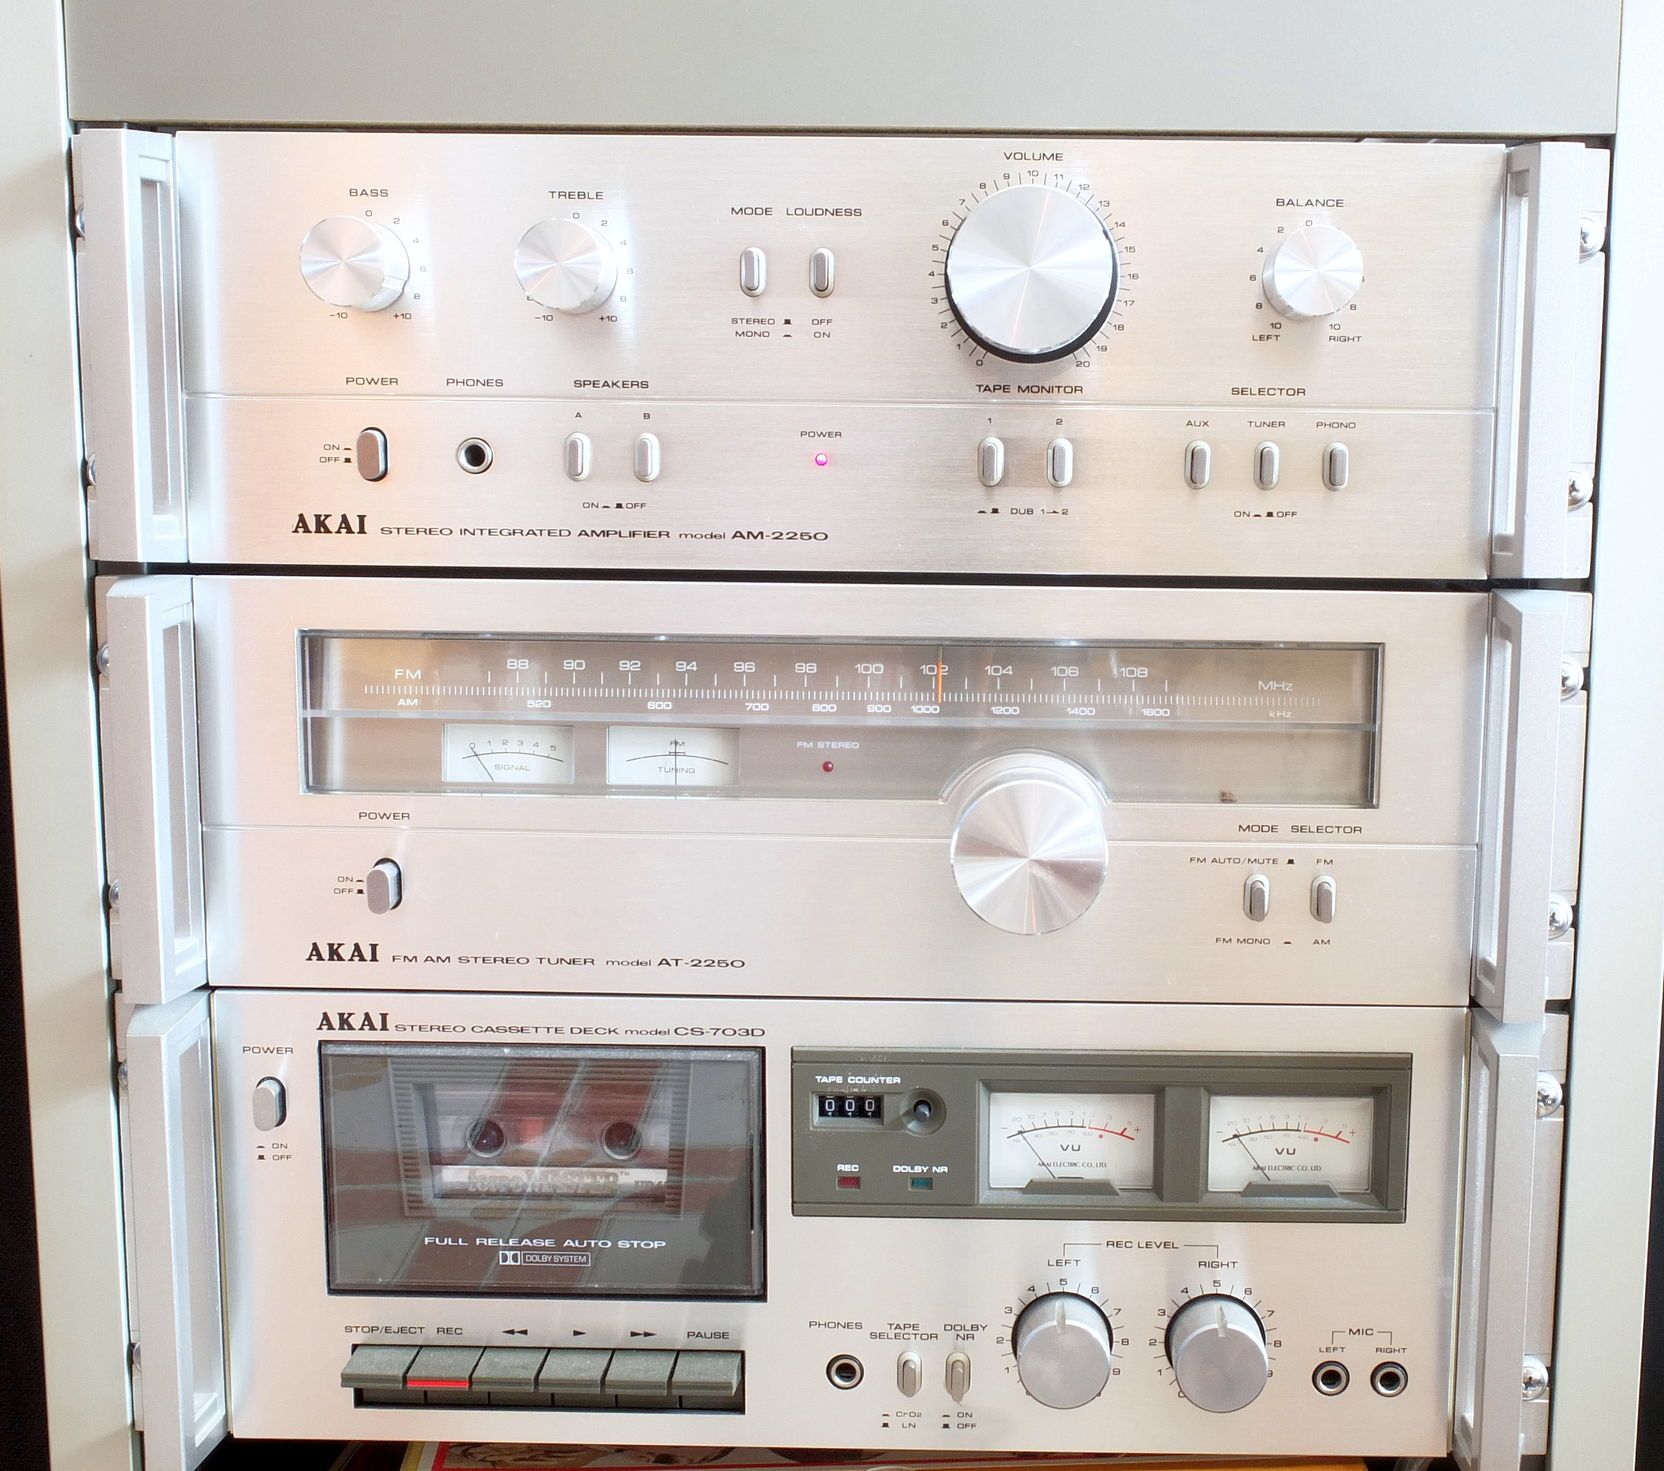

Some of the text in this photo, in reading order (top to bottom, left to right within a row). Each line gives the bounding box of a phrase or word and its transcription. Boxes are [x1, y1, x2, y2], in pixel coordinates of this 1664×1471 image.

[1004, 152, 1063, 161] VOLUME
[349, 189, 388, 197] BASS
[549, 191, 603, 200] TREBLE
[1276, 198, 1344, 207] BALANCE
[731, 207, 862, 216] MODE LOUDNESS
[812, 318, 832, 326] OFF
[346, 377, 398, 385] POWER
[446, 378, 503, 387] PHONES
[574, 380, 649, 389] SPEAKERS
[976, 385, 1083, 394] TAPE MONITOR
[1232, 387, 1305, 396] SELECTOR
[292, 513, 828, 541] AKAI STEREO INTEGRATED AMPLIFIER model AM-2250
[507, 659, 1148, 678] 88 90 92 94 96 98 100 102 104 106 108
[395, 669, 421, 679] FM
[1259, 681, 1293, 691] MHz
[527, 700, 551, 708] 520
[647, 701, 672, 710] 600
[745, 703, 769, 711] 700
[812, 704, 836, 712] 800
[911, 705, 939, 713] 1000
[991, 706, 1019, 714] 1200
[1142, 708, 1170, 716] 1600
[1270, 710, 1292, 718] kHz
[359, 812, 410, 820] POWER
[1291, 825, 1362, 834] SELECTOR
[306, 942, 379, 962] AKAI
[392, 955, 418, 963] FM
[424, 956, 450, 964] AM
[458, 956, 529, 965] STEREO
[536, 957, 594, 965] TUNER
[657, 958, 745, 968] AT-2250
[316, 1012, 389, 1031] AKAI
[395, 1024, 466, 1032] STEREO
[471, 1025, 564, 1034] CASSETTE
[570, 1026, 619, 1035] DECK
[674, 1027, 765, 1037] CS-703D
[243, 1046, 293, 1054] POWER
[848, 1076, 900, 1084] COUNTER
[837, 1164, 859, 1172] REC
[893, 1165, 929, 1173] DOLBY
[425, 1237, 666, 1249] FULL RELEASE AUTO STOP
[1138, 1241, 1179, 1249] LEVEL
[809, 1321, 862, 1329] PHONES
[887, 1323, 919, 1331] TAPE
[344, 1325, 425, 1335] STOP/EJECT
[437, 1326, 463, 1335] REC
[1349, 1328, 1373, 1336] MIC
[687, 1331, 729, 1339] PAUSE
[870, 1332, 938, 1340] SELECTOR
